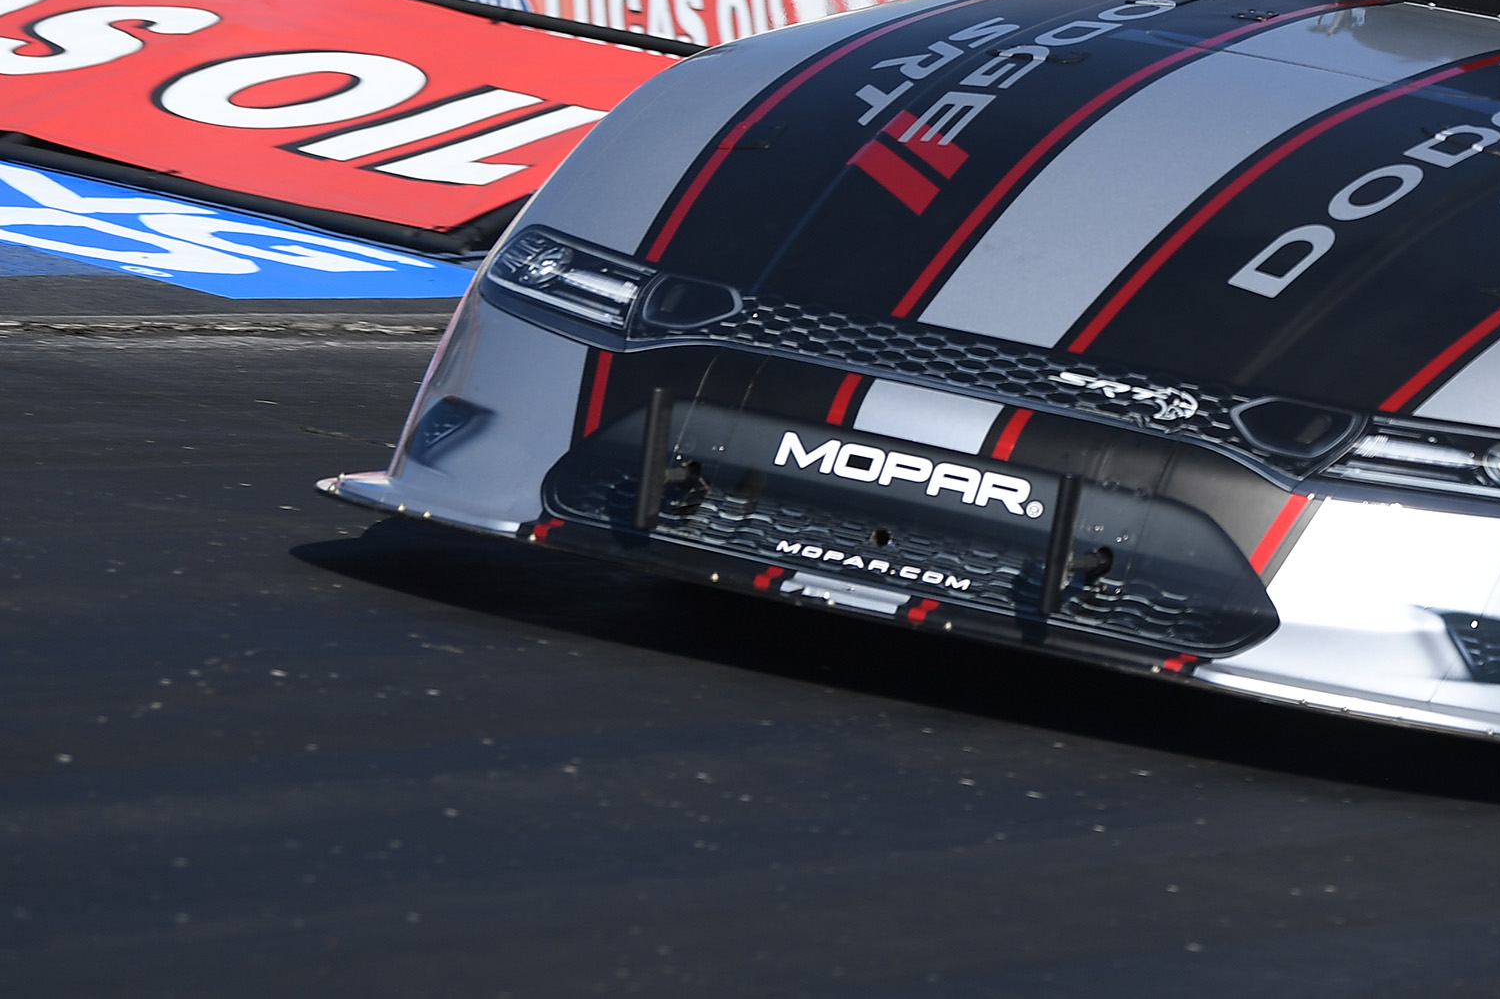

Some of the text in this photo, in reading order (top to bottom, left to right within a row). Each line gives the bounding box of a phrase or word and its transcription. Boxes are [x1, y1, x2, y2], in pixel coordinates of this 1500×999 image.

[150, 49, 610, 185] OIL
[854, 16, 1021, 127] SRT
[776, 540, 971, 591] MOPAR.COM
